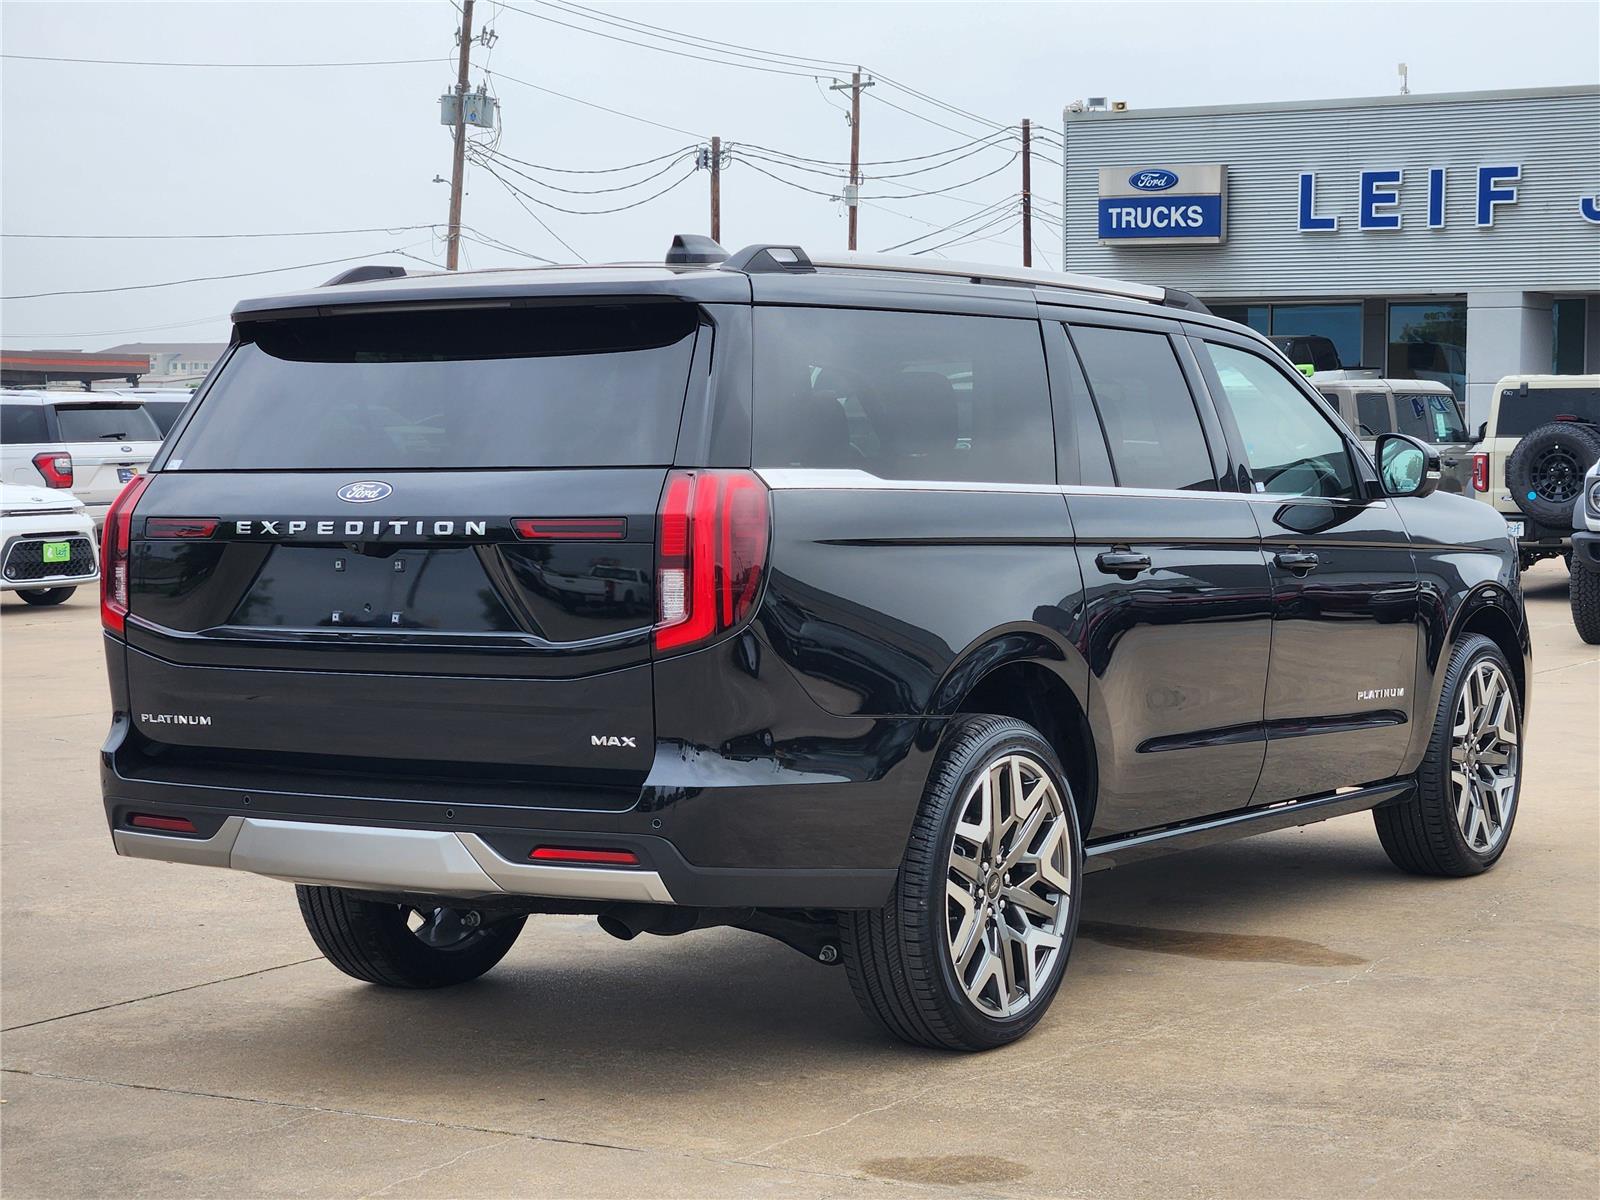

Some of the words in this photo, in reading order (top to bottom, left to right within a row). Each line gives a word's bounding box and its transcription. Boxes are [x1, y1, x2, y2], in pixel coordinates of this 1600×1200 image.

[1137, 173, 1167, 188] Ford
[1298, 165, 1522, 231] LEIF
[1108, 205, 1203, 229] TRUCKS
[346, 484, 382, 498] Ford
[236, 520, 487, 536] EXPEDITION
[1356, 687, 1405, 701] PLATINUM
[140, 713, 212, 726] PLATINUM
[591, 735, 636, 748] MAX
